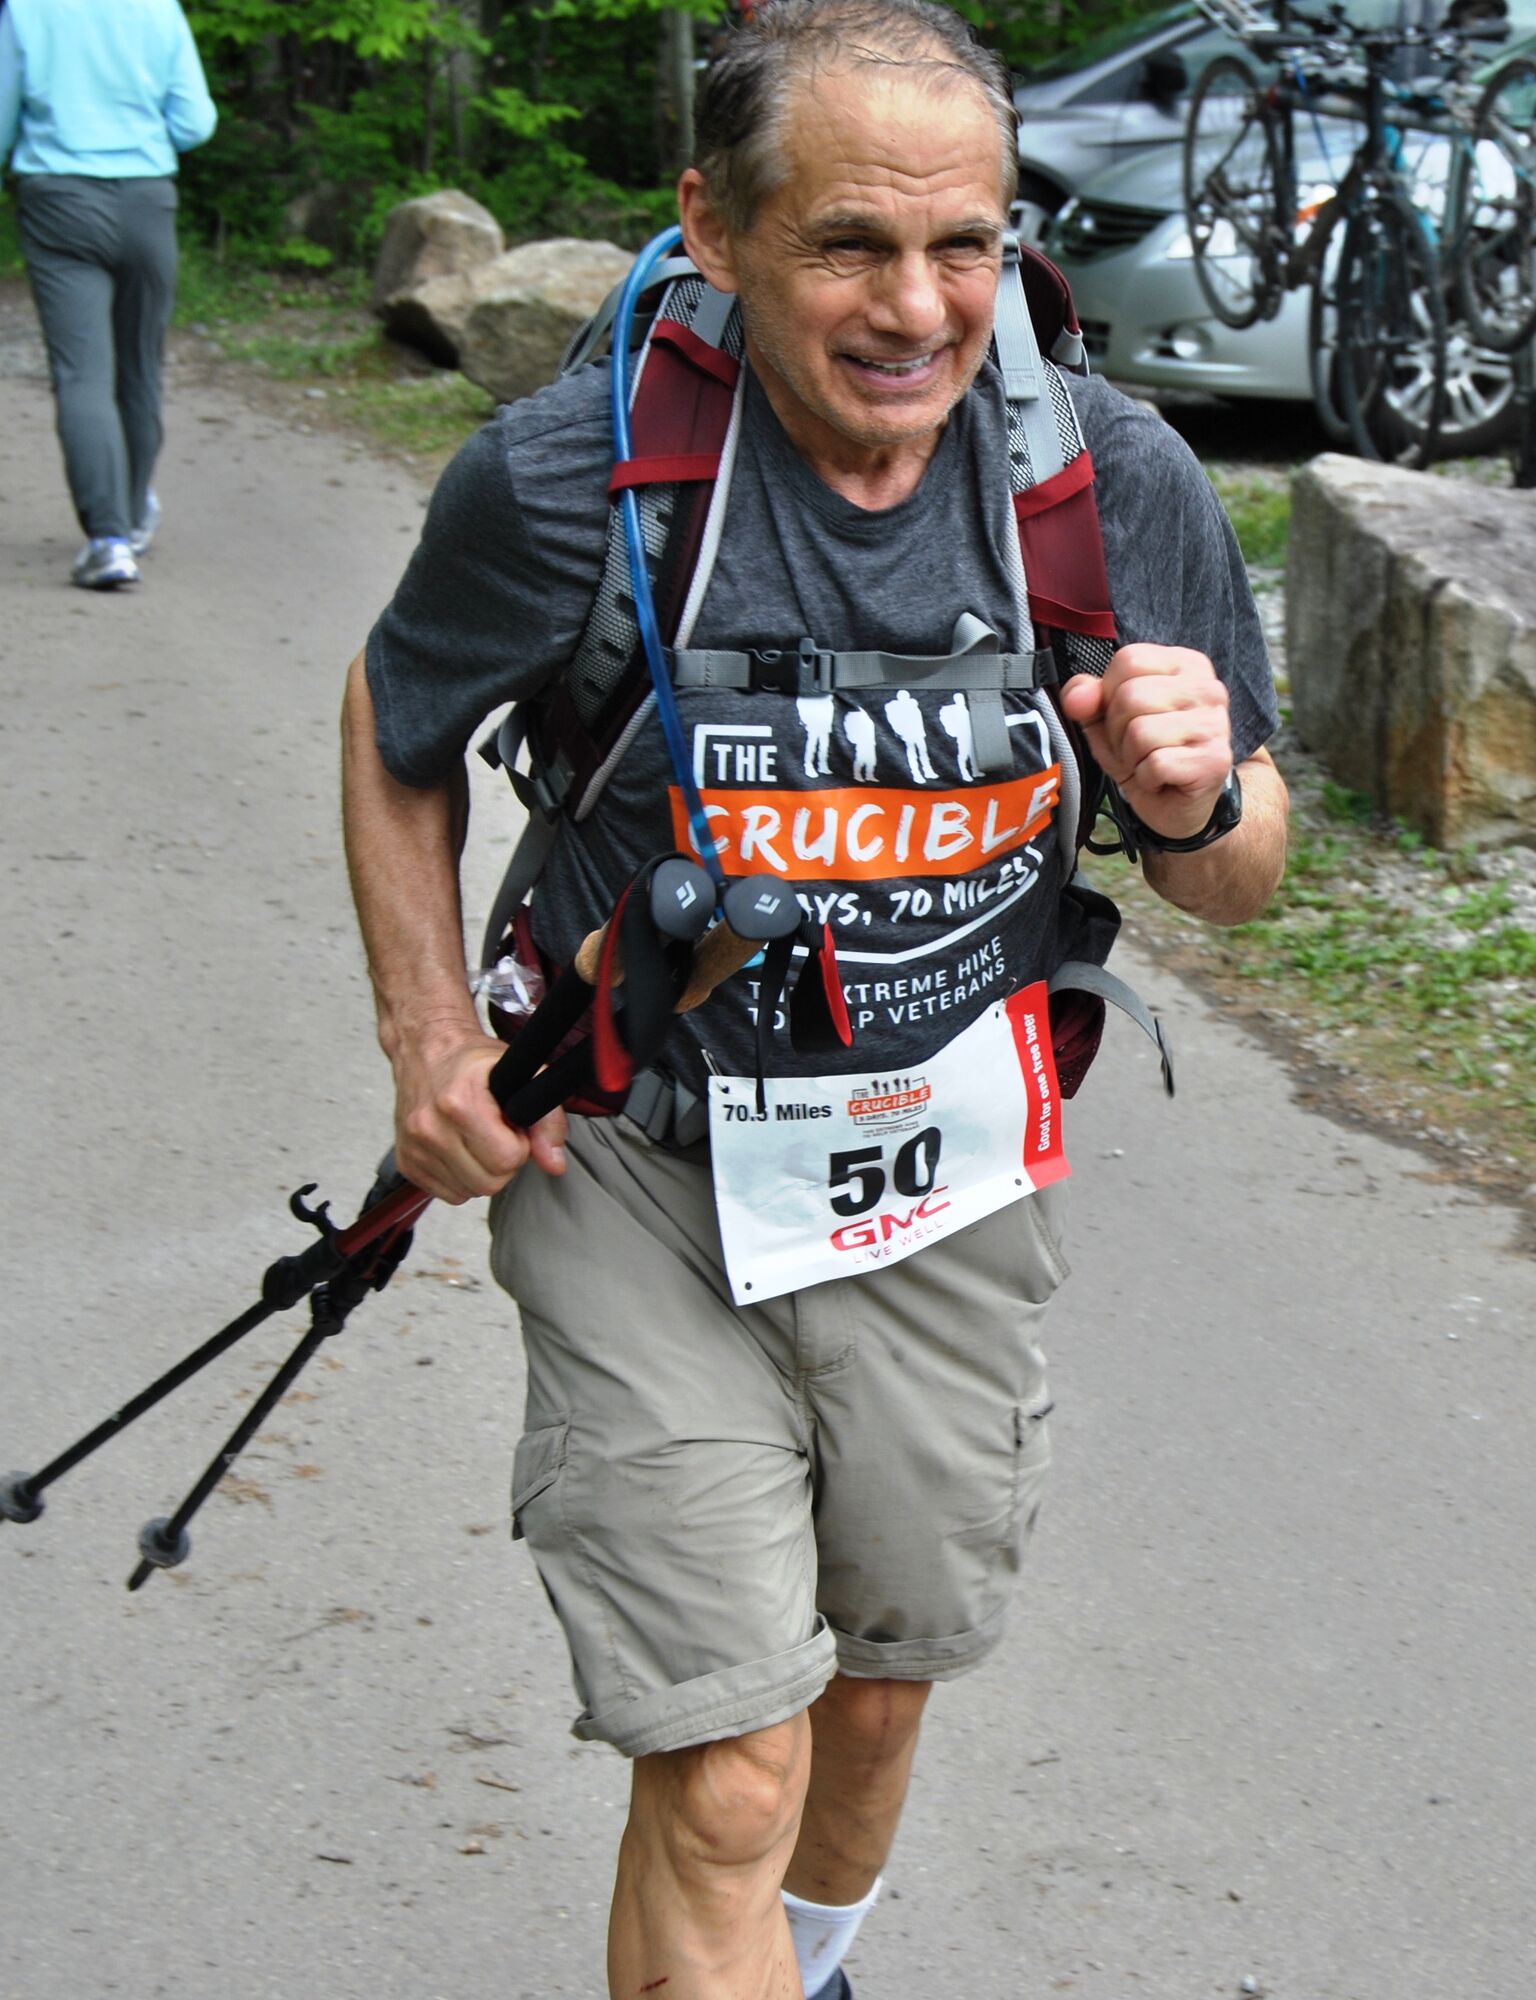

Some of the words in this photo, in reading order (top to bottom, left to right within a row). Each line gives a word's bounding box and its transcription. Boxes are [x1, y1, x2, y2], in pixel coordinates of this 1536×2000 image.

[712, 744, 778, 783] THE
[688, 777, 1058, 873] CRUCIBLE
[889, 888, 933, 924] 70
[943, 856, 1030, 915] MILES
[842, 969, 948, 1005] XTREME
[957, 935, 1003, 980] HIKE
[887, 956, 1006, 1025] VETERANS
[1023, 1013, 1038, 1045] beer
[1030, 1043, 1044, 1074] free
[850, 1086, 930, 1114] CRUCIBLE
[1037, 1073, 1050, 1100] one
[775, 1103, 832, 1121] Miles
[1039, 1101, 1052, 1121] for
[1037, 1119, 1051, 1152] Good
[828, 1126, 942, 1217] 50
[854, 1245, 893, 1264] LIVE
[899, 1219, 944, 1246] WELL
